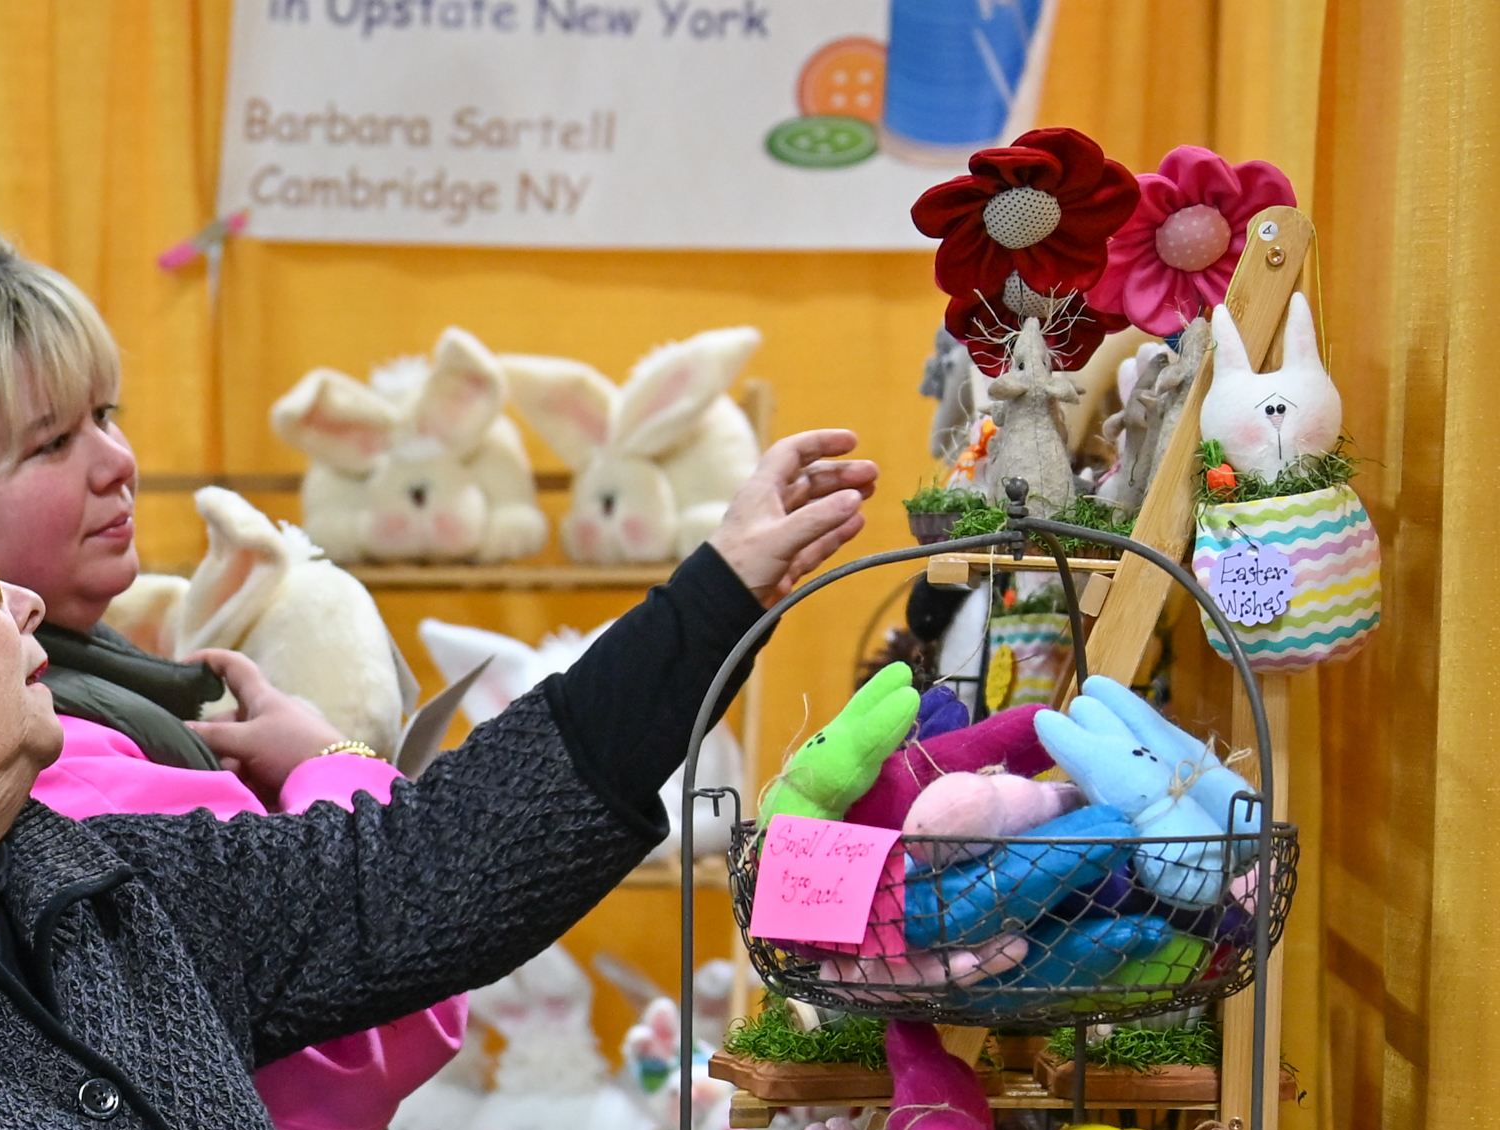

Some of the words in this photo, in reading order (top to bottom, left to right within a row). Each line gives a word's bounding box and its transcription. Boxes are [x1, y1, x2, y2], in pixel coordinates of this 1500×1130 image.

[326, 0, 518, 40] Upstate
[534, 0, 640, 38] New
[658, 0, 770, 40] York
[243, 98, 432, 150] Barbara
[450, 105, 617, 154] Sartell
[248, 164, 499, 225] Cambridge
[514, 174, 590, 218] NY
[1221, 552, 1288, 586] Easter
[1218, 590, 1285, 618] Wishes
